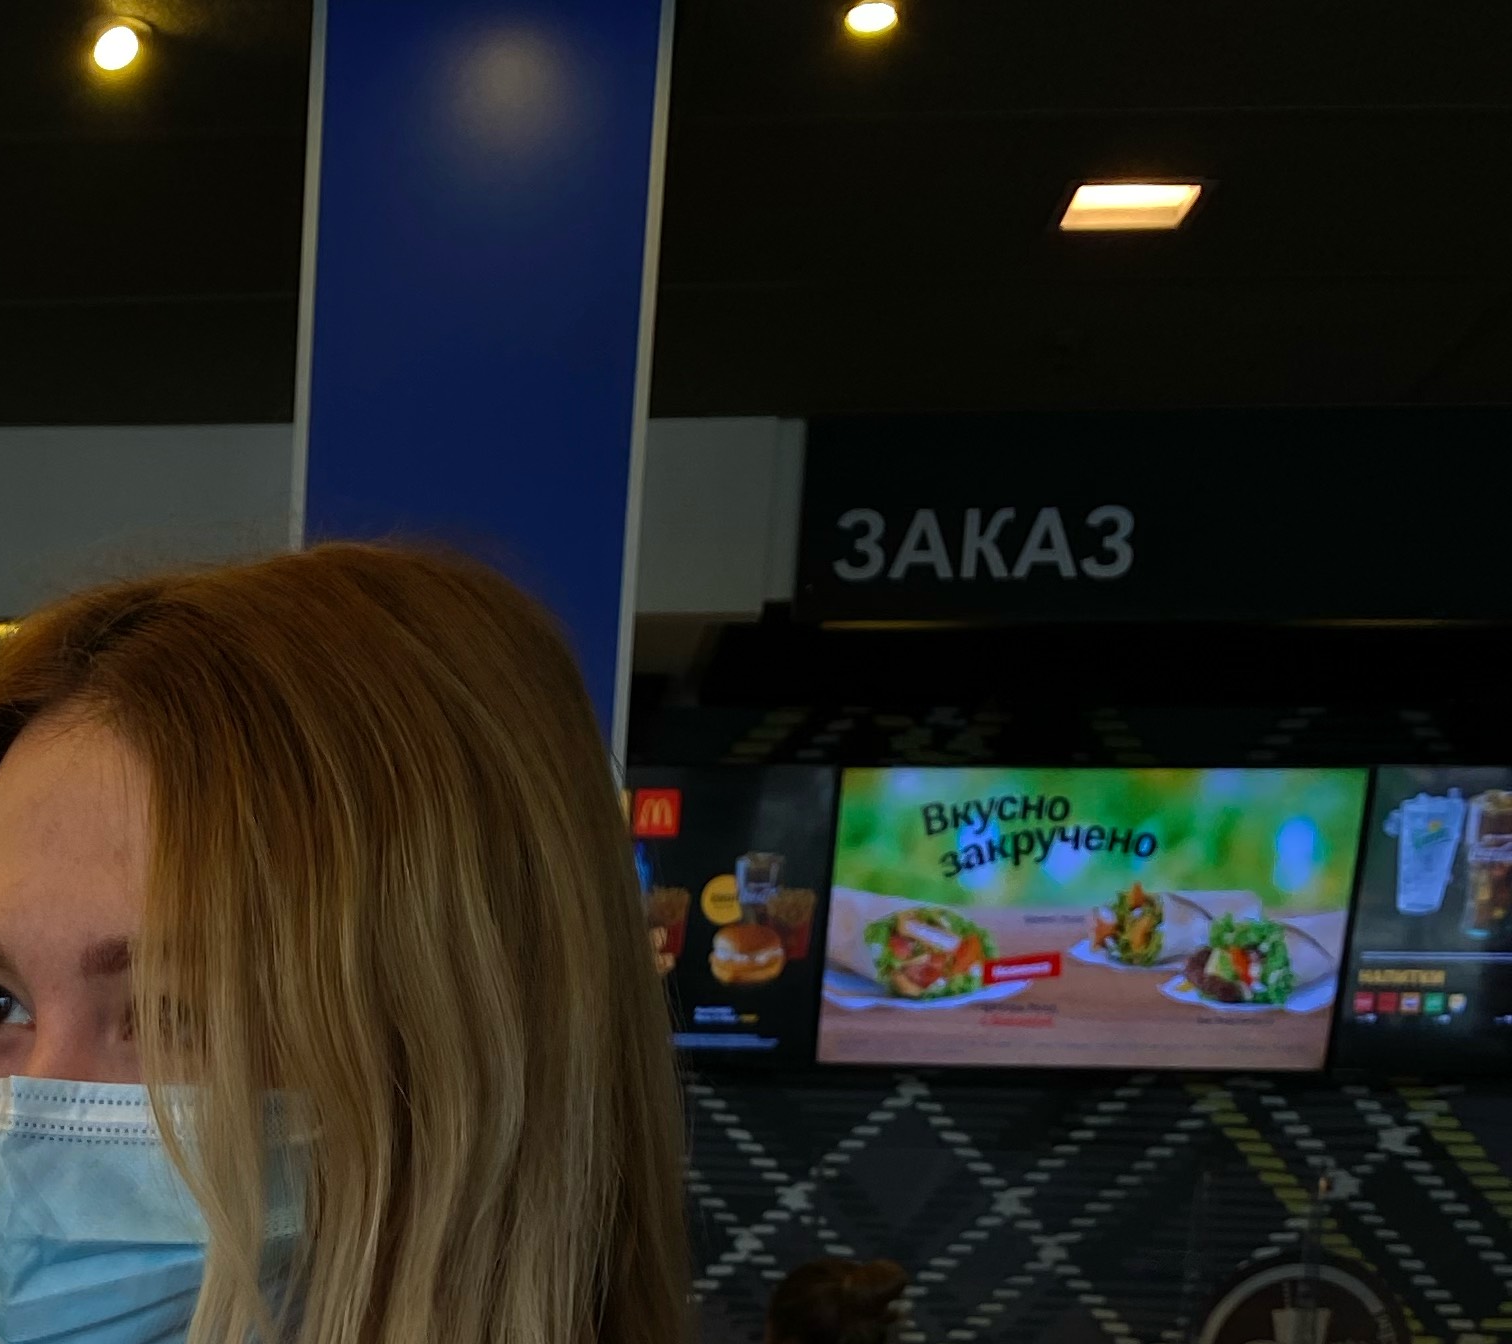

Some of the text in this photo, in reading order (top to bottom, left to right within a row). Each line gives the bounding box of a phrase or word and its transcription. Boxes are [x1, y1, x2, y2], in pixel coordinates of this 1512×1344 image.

[833, 504, 1135, 580] ЗАКАЗ
[922, 795, 1071, 836] Вкусно
[940, 824, 1157, 878] закручено
